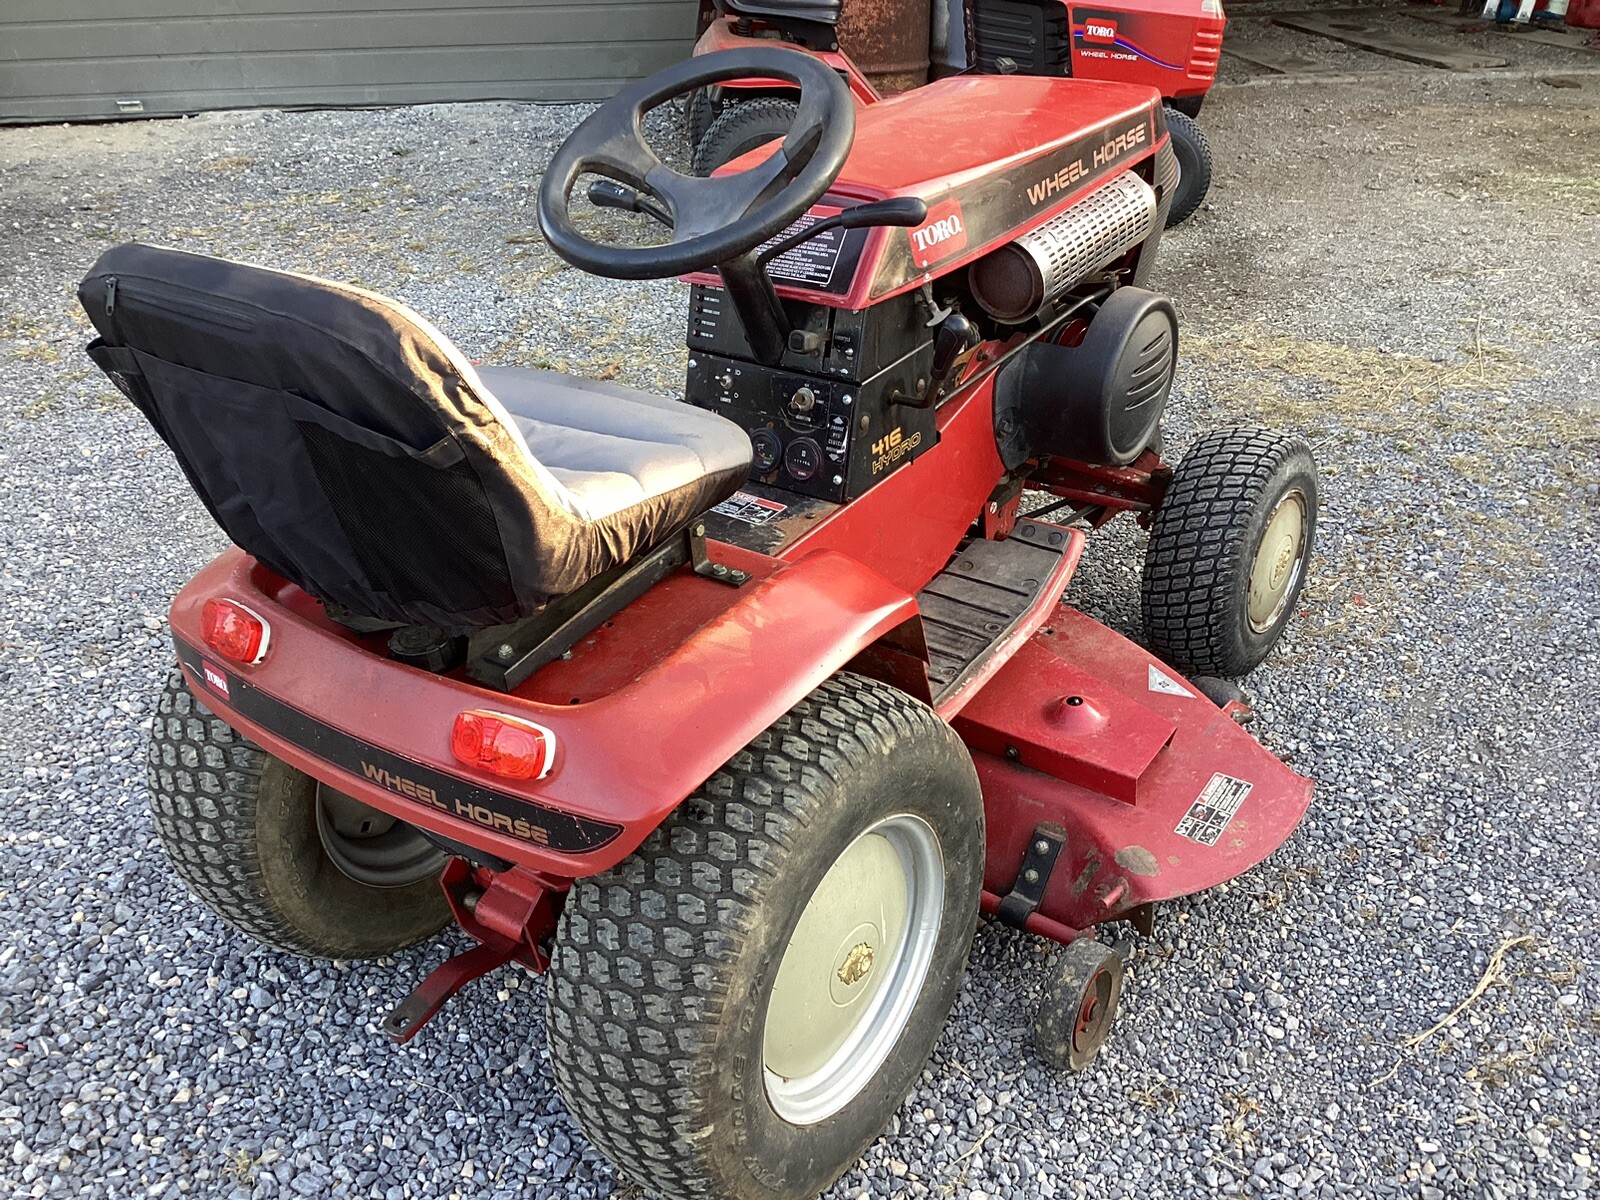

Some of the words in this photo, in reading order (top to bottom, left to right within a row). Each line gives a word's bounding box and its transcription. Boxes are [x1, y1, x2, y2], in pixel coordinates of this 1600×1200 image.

[1087, 25, 1114, 38] TORO
[1080, 50, 1108, 59] WHEEL
[1111, 53, 1138, 61] HORSE
[1026, 158, 1089, 205] WHEEL
[1093, 123, 1146, 168] HORSE
[913, 214, 962, 251] TORO
[871, 427, 902, 455] 416
[872, 431, 922, 475] HYDRO
[361, 760, 448, 809] WHEEL
[455, 798, 549, 845] HORSE
